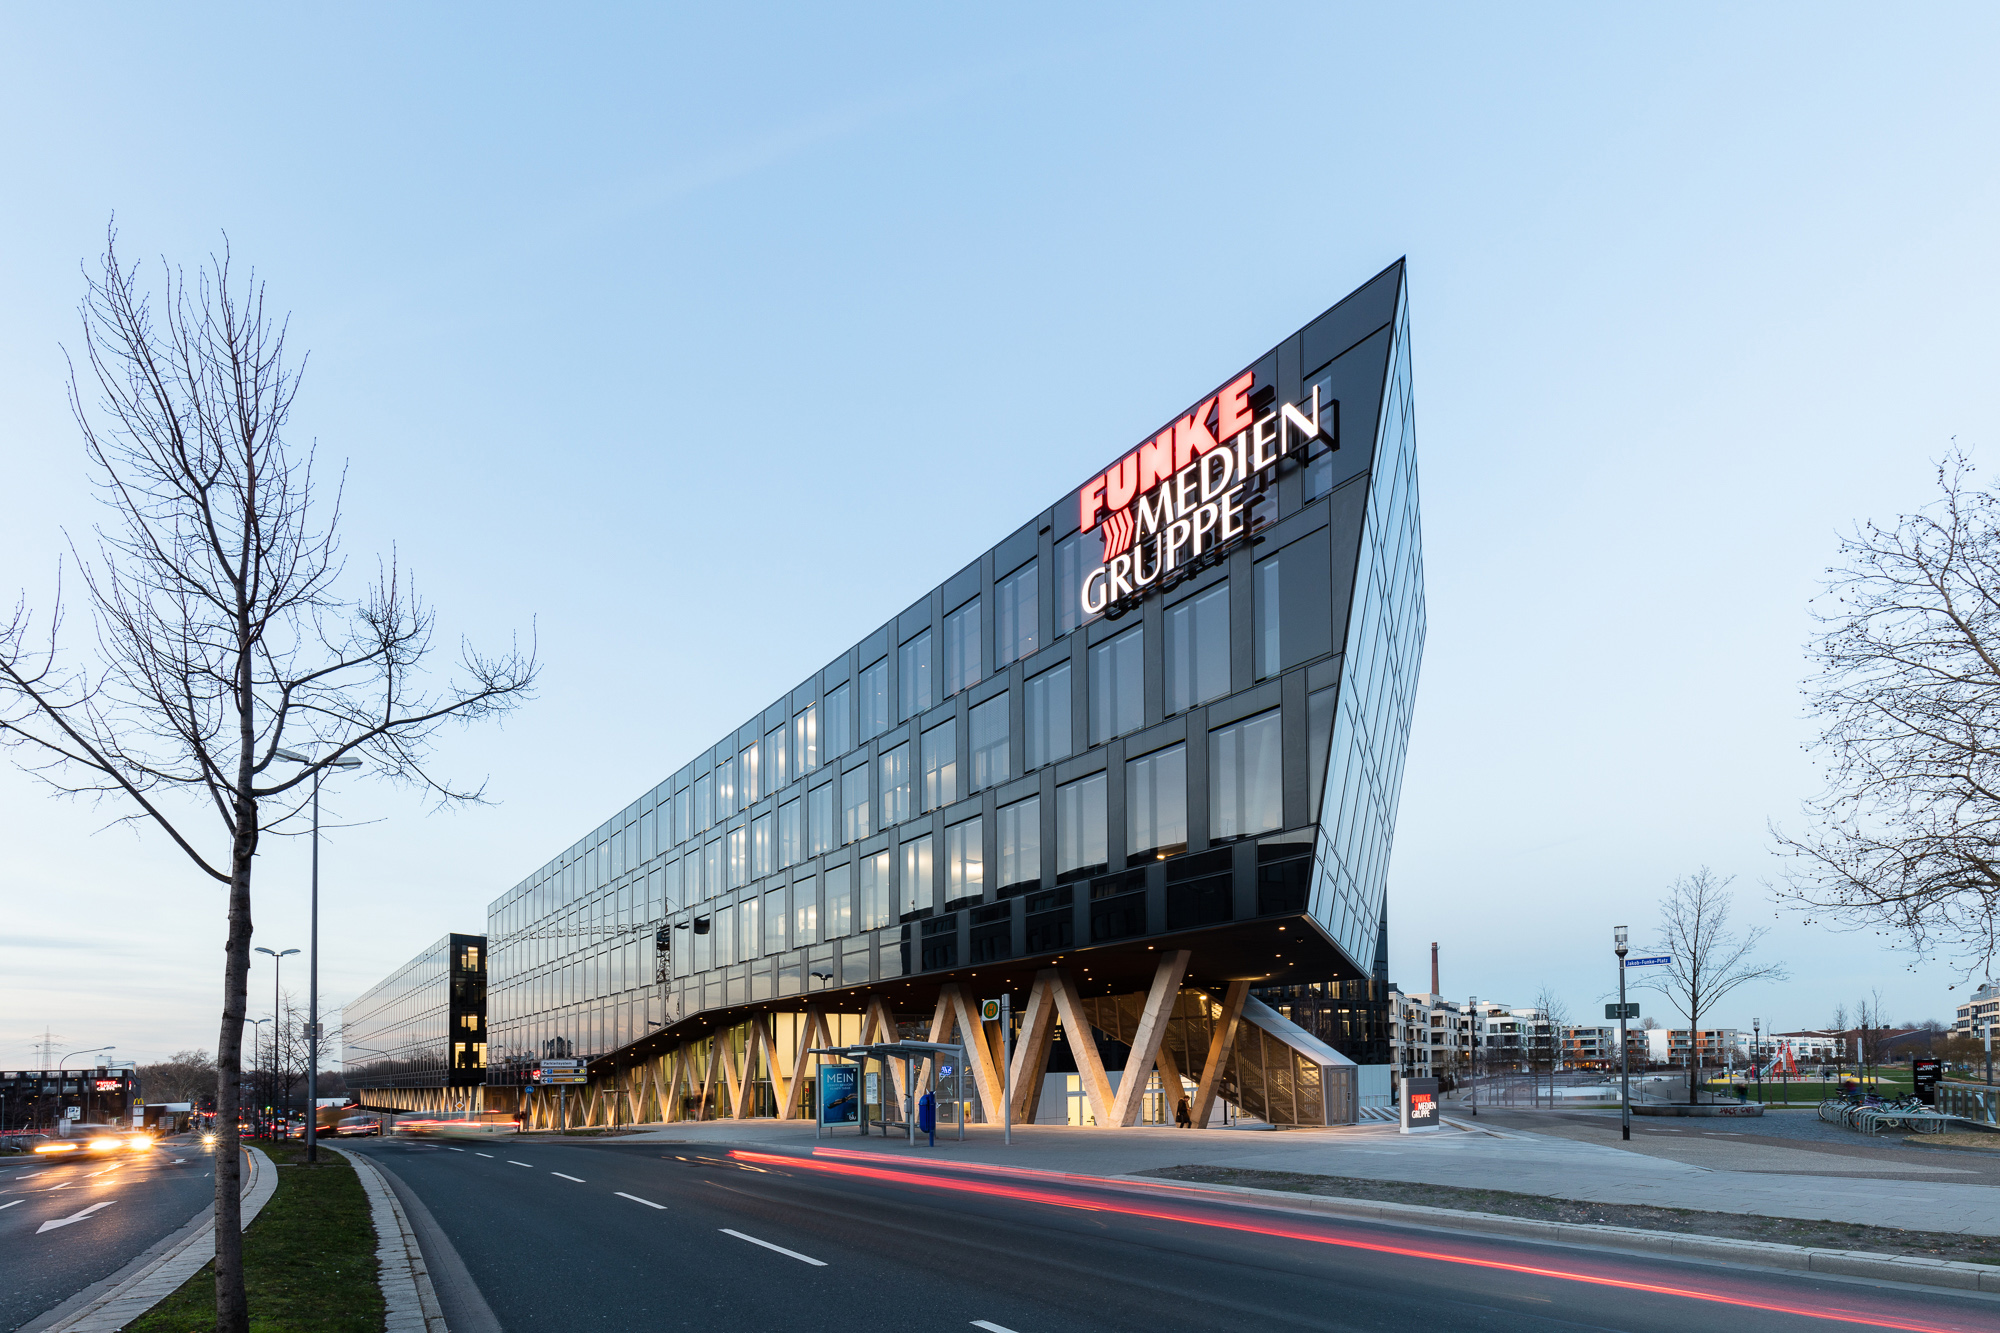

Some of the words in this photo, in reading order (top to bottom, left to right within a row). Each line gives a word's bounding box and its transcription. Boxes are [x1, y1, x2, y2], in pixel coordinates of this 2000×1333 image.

[1080, 371, 1253, 533] FUNKE
[1135, 384, 1320, 543] MEDIEN
[1081, 483, 1244, 614] GRUPPE
[1627, 957, 1669, 966] Jakob-Funke-Platz
[827, 1073, 854, 1083] MEIN
[1411, 1094, 1431, 1103] FUNKE
[1418, 1101, 1436, 1110] MEDIEN
[1411, 1110, 1430, 1118] GRUPPE
